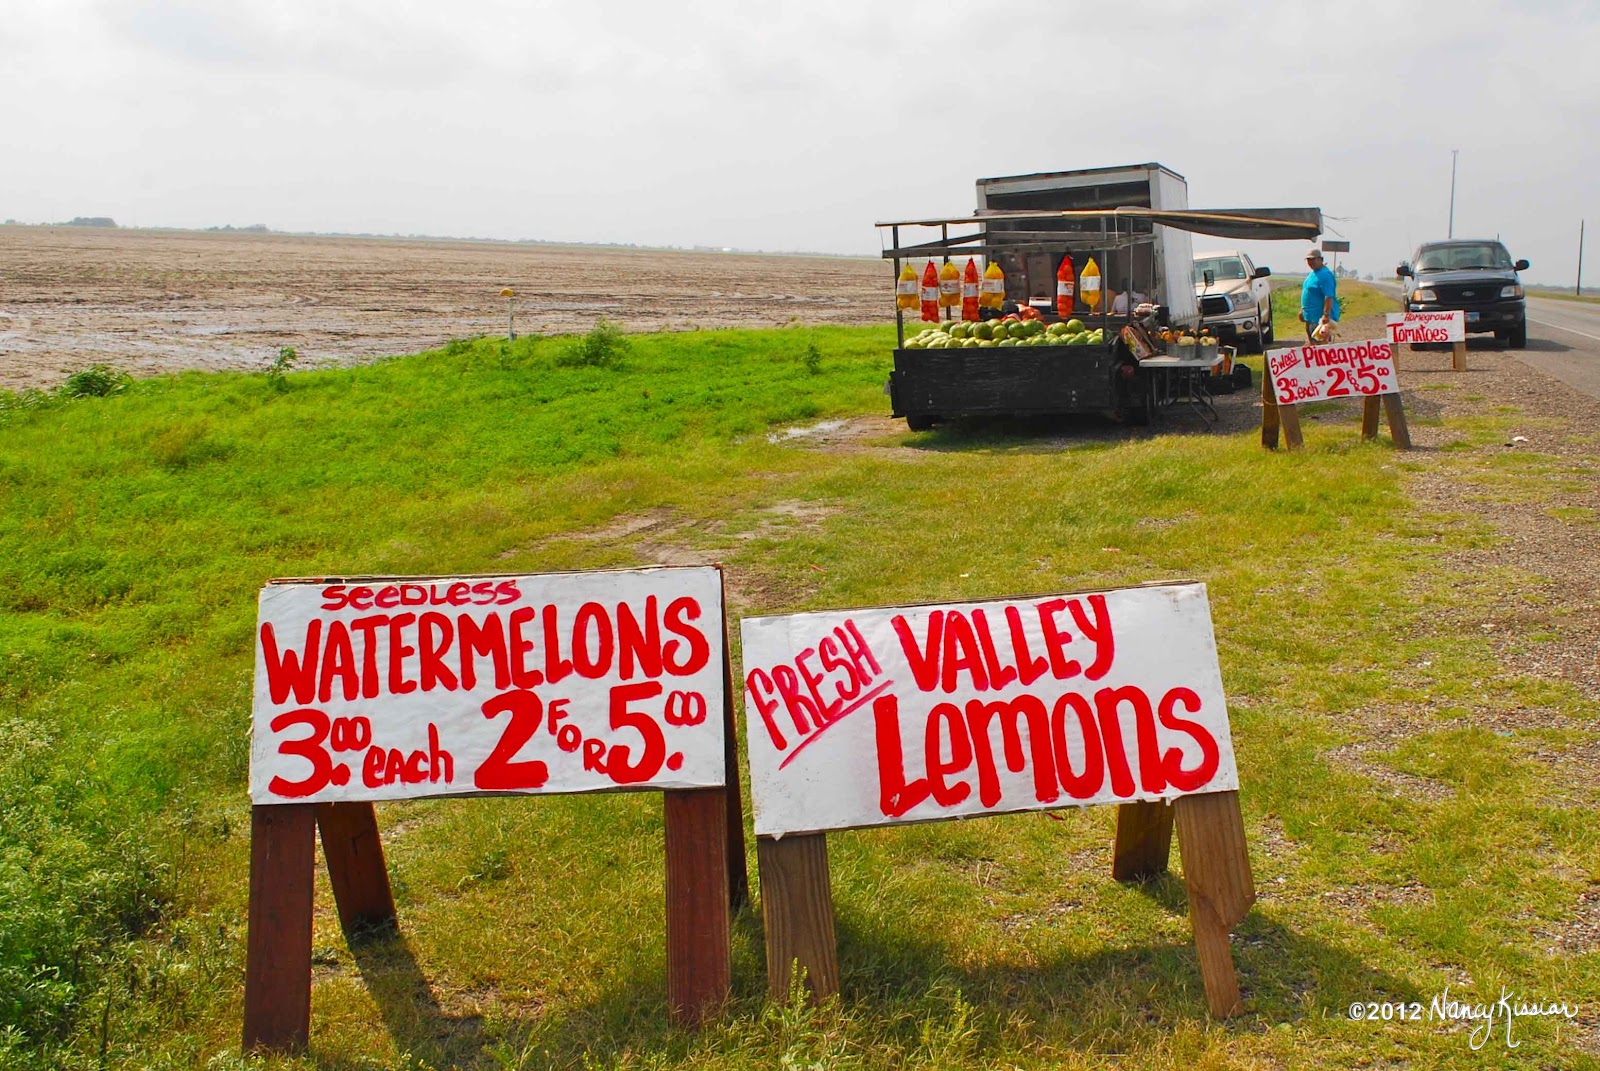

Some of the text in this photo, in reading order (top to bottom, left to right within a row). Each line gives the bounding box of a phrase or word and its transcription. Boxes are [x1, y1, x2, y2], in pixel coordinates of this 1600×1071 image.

[1301, 341, 1392, 368] Pineapples
[1326, 368, 1350, 397] 2
[260, 594, 711, 706] WATERMELONS
[744, 594, 1115, 752] FRESH VALLEY
[474, 689, 549, 790] 2
[548, 697, 611, 774] FOR
[873, 686, 1220, 818] Lemons
